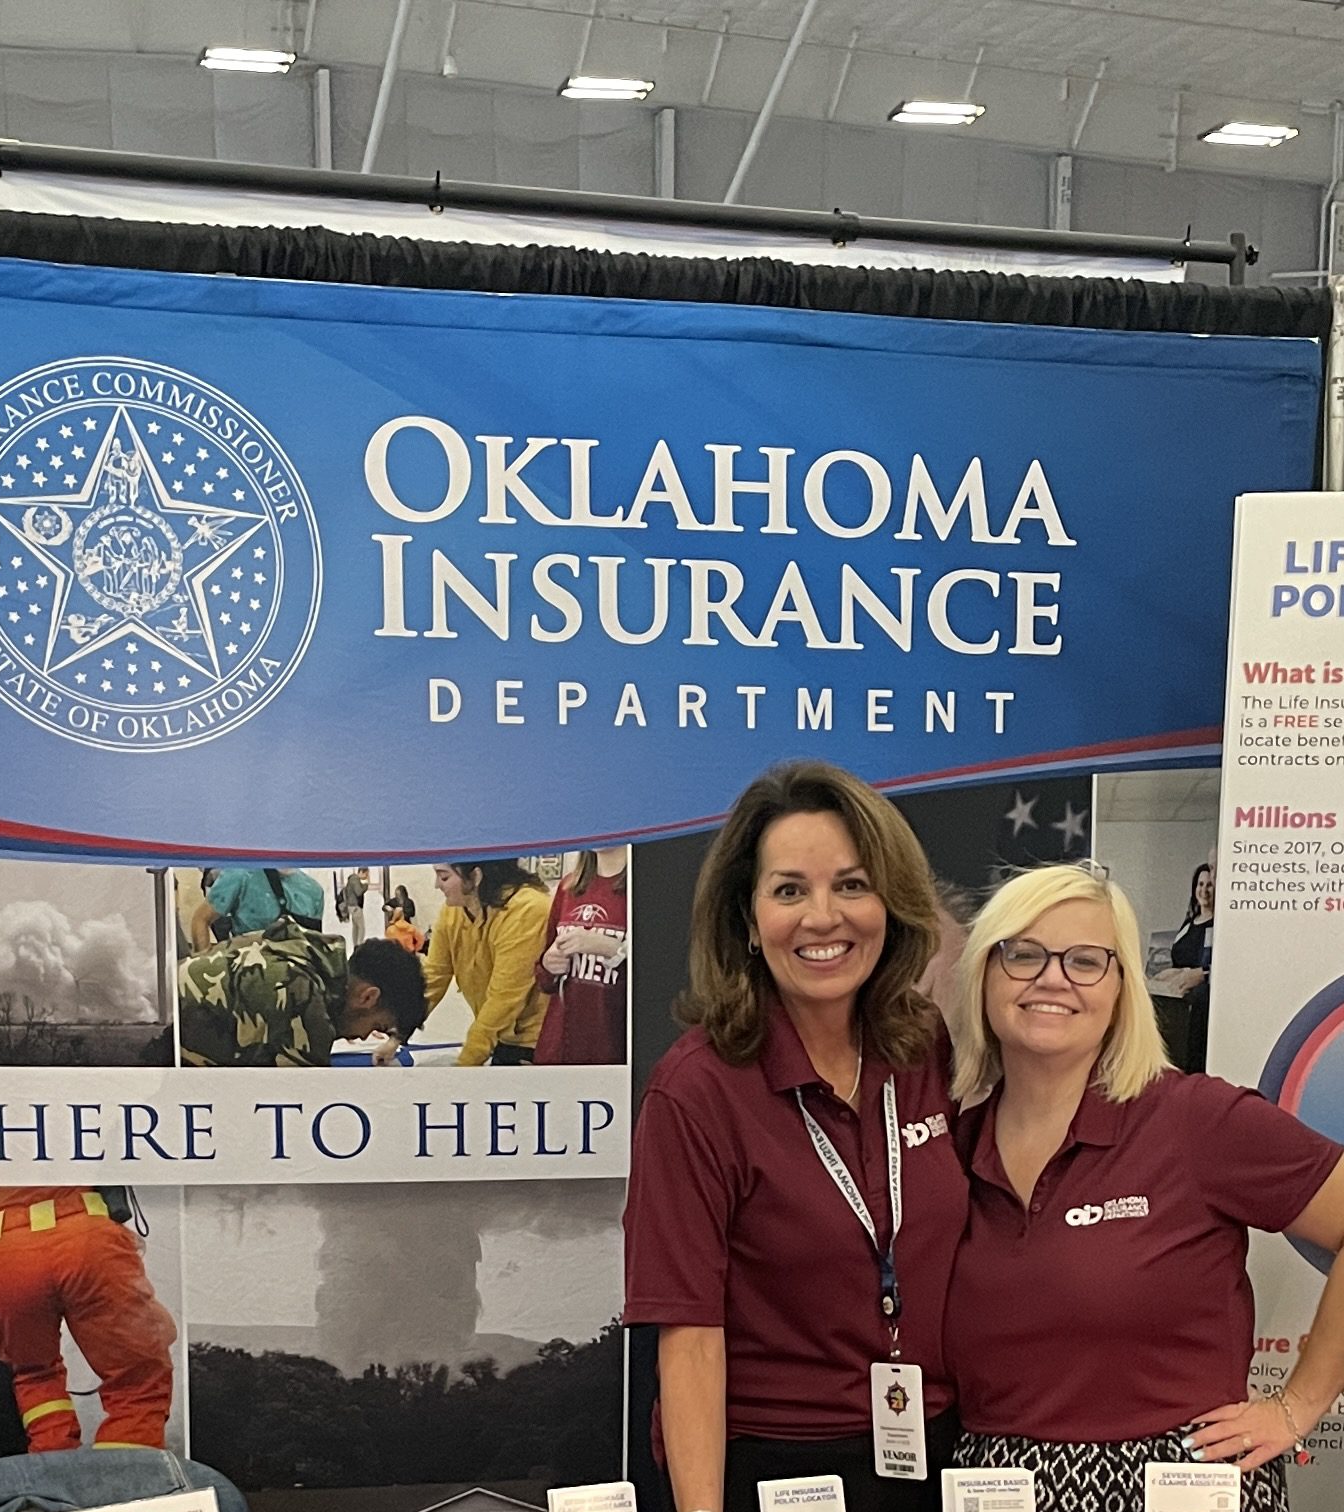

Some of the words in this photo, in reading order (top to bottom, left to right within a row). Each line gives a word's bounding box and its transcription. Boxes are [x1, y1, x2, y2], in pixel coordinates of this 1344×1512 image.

[92, 371, 299, 524] COMMISSIONER
[362, 414, 1078, 547] OKLAHOMA
[371, 534, 1064, 656] INSURANCE
[68, 705, 109, 733] OF
[117, 655, 282, 739] OKLAHOMA
[1242, 661, 1316, 685] What
[1322, 661, 1344, 684] is
[428, 678, 1015, 734] DEPARTMENT
[1240, 717, 1254, 729] is
[1258, 717, 1268, 728] a
[1273, 714, 1319, 728] FREE
[1241, 695, 1273, 710] The
[1278, 695, 1310, 710] Life
[1234, 806, 1337, 829] Millions
[1229, 898, 1298, 912] amount
[1302, 897, 1321, 911] of
[254, 1101, 372, 1161] TO
[414, 1099, 616, 1159] HELP
